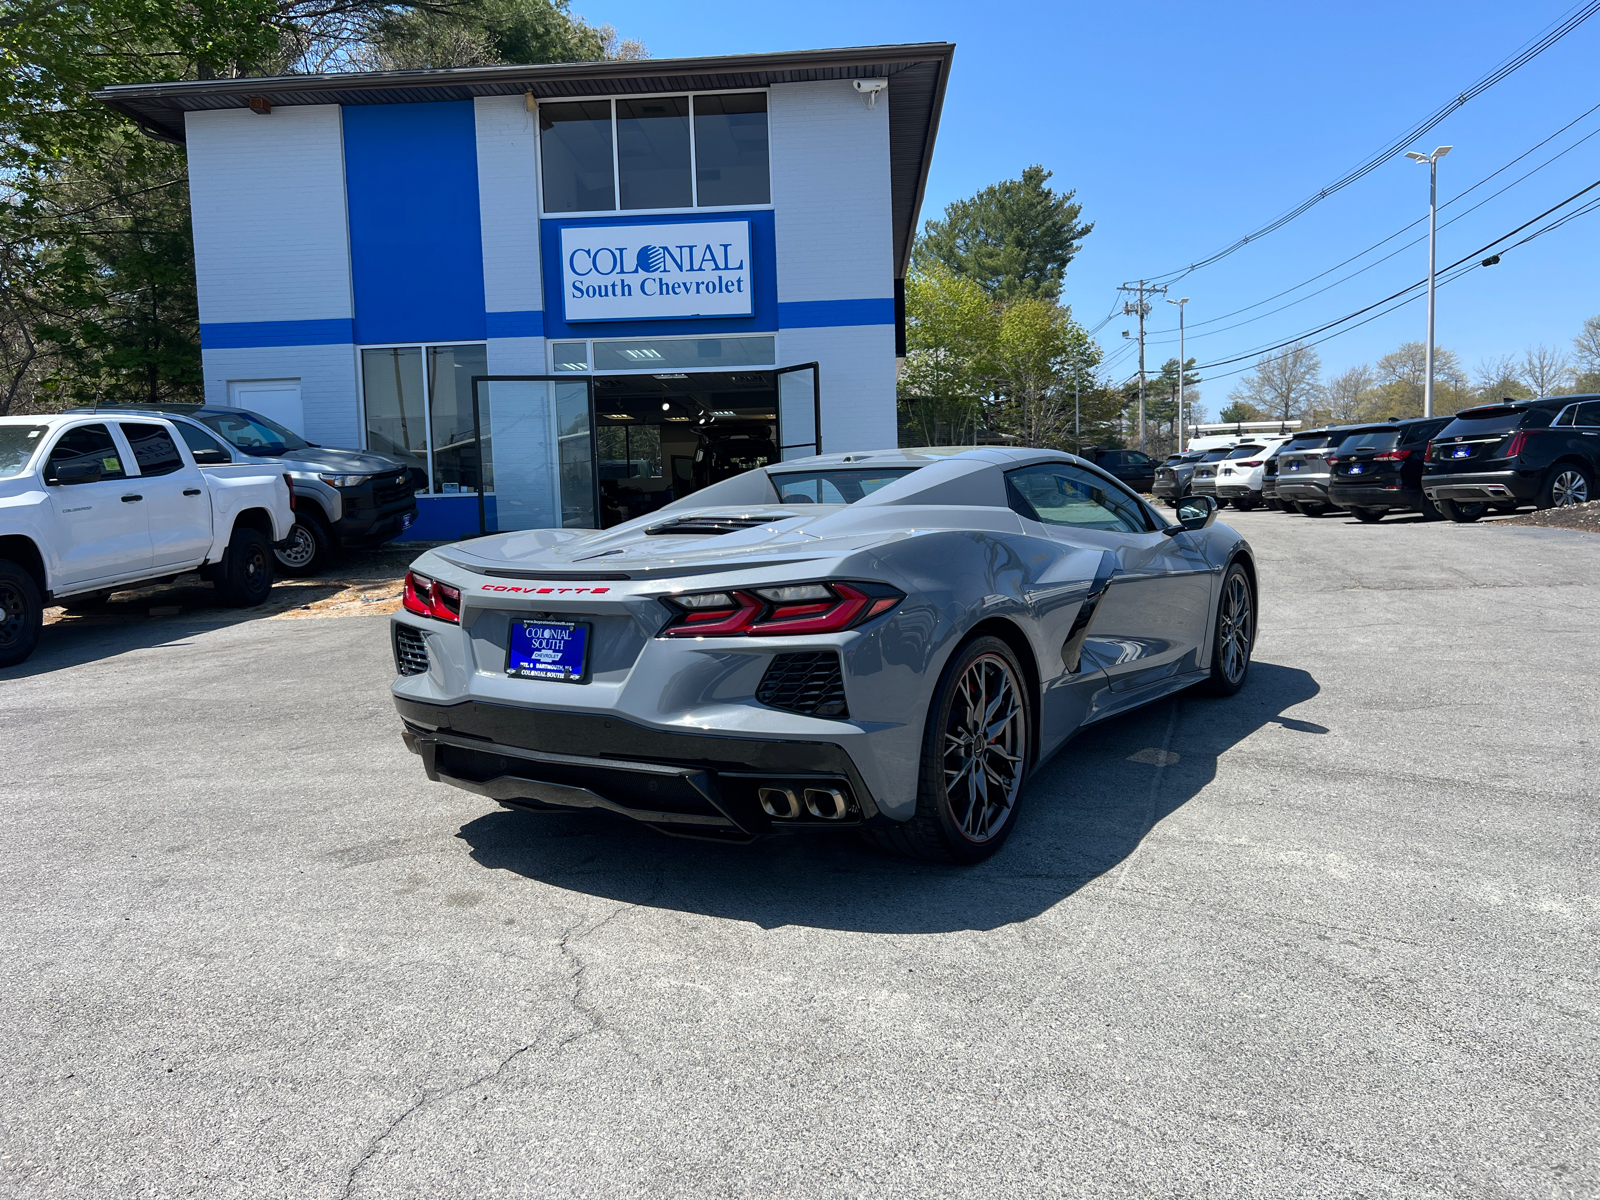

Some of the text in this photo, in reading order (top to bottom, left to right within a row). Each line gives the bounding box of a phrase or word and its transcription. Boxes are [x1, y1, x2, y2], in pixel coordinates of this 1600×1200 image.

[569, 243, 744, 276] COLONIAL
[572, 275, 744, 299] South Chevrolet
[481, 584, 610, 594] CORVETTE
[525, 627, 572, 640] COLONIAL
[531, 638, 564, 650] SOUTH
[547, 671, 565, 679] SOUTH
